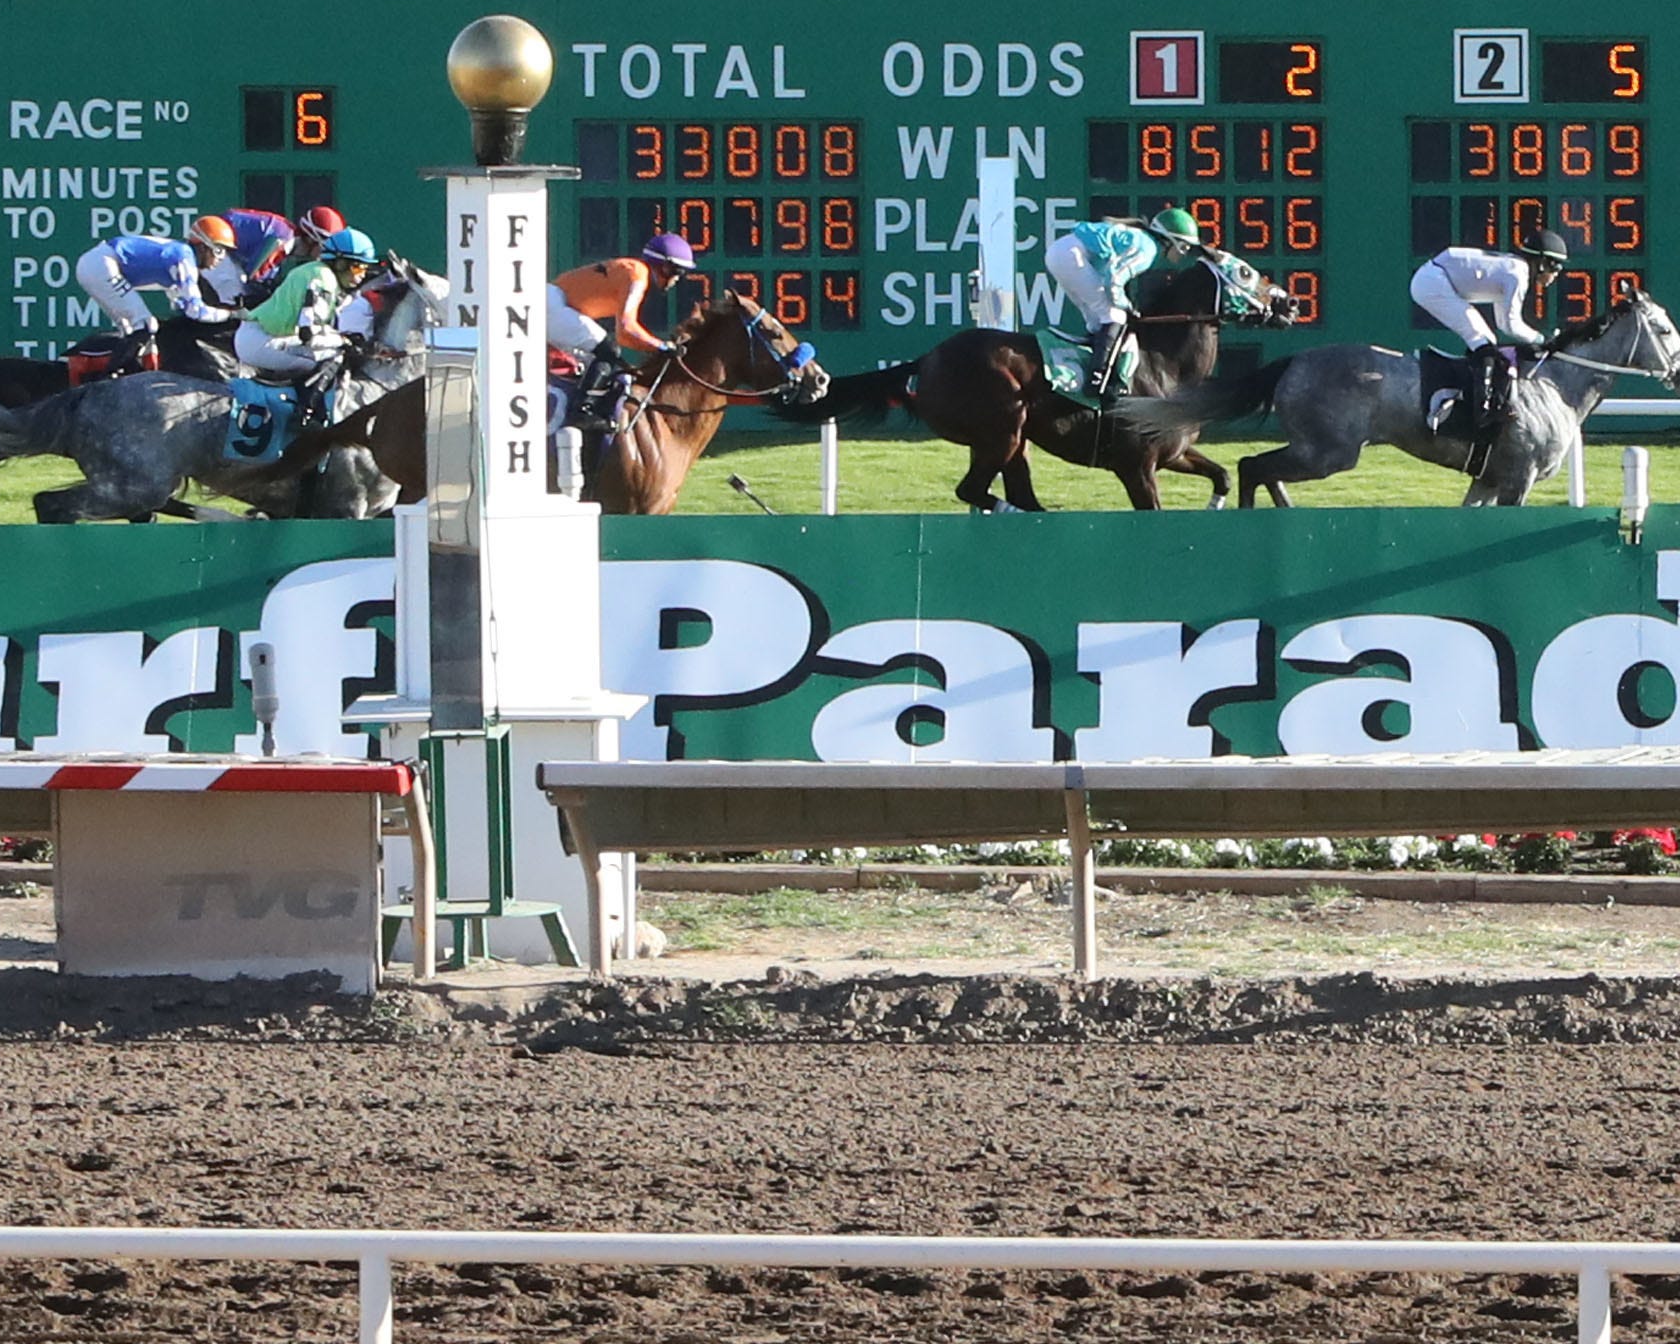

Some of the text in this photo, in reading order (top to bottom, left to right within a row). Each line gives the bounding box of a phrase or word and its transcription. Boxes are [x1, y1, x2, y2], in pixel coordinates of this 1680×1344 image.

[572, 41, 1084, 99] TOTAL ODDS
[1154, 42, 1180, 95] 1
[1285, 44, 1317, 97] 2
[1477, 41, 1506, 90] 2
[1608, 44, 1641, 97] 5
[10, 98, 190, 140] RACE NO
[296, 92, 328, 145] 6
[636, 126, 854, 179] 33808
[897, 126, 1046, 180] WIN
[1140, 125, 1317, 177] 8512
[1469, 124, 1641, 177] 3869
[2, 166, 199, 199] MINUTES
[3, 206, 198, 240] TO POST
[654, 199, 854, 252] 10798
[875, 198, 1078, 253] PLACE
[13, 296, 118, 328] TIM
[881, 271, 1066, 327] SHW
[507, 214, 531, 474] FINISH
[232, 404, 274, 457] 9
[164, 870, 360, 921] TVG
